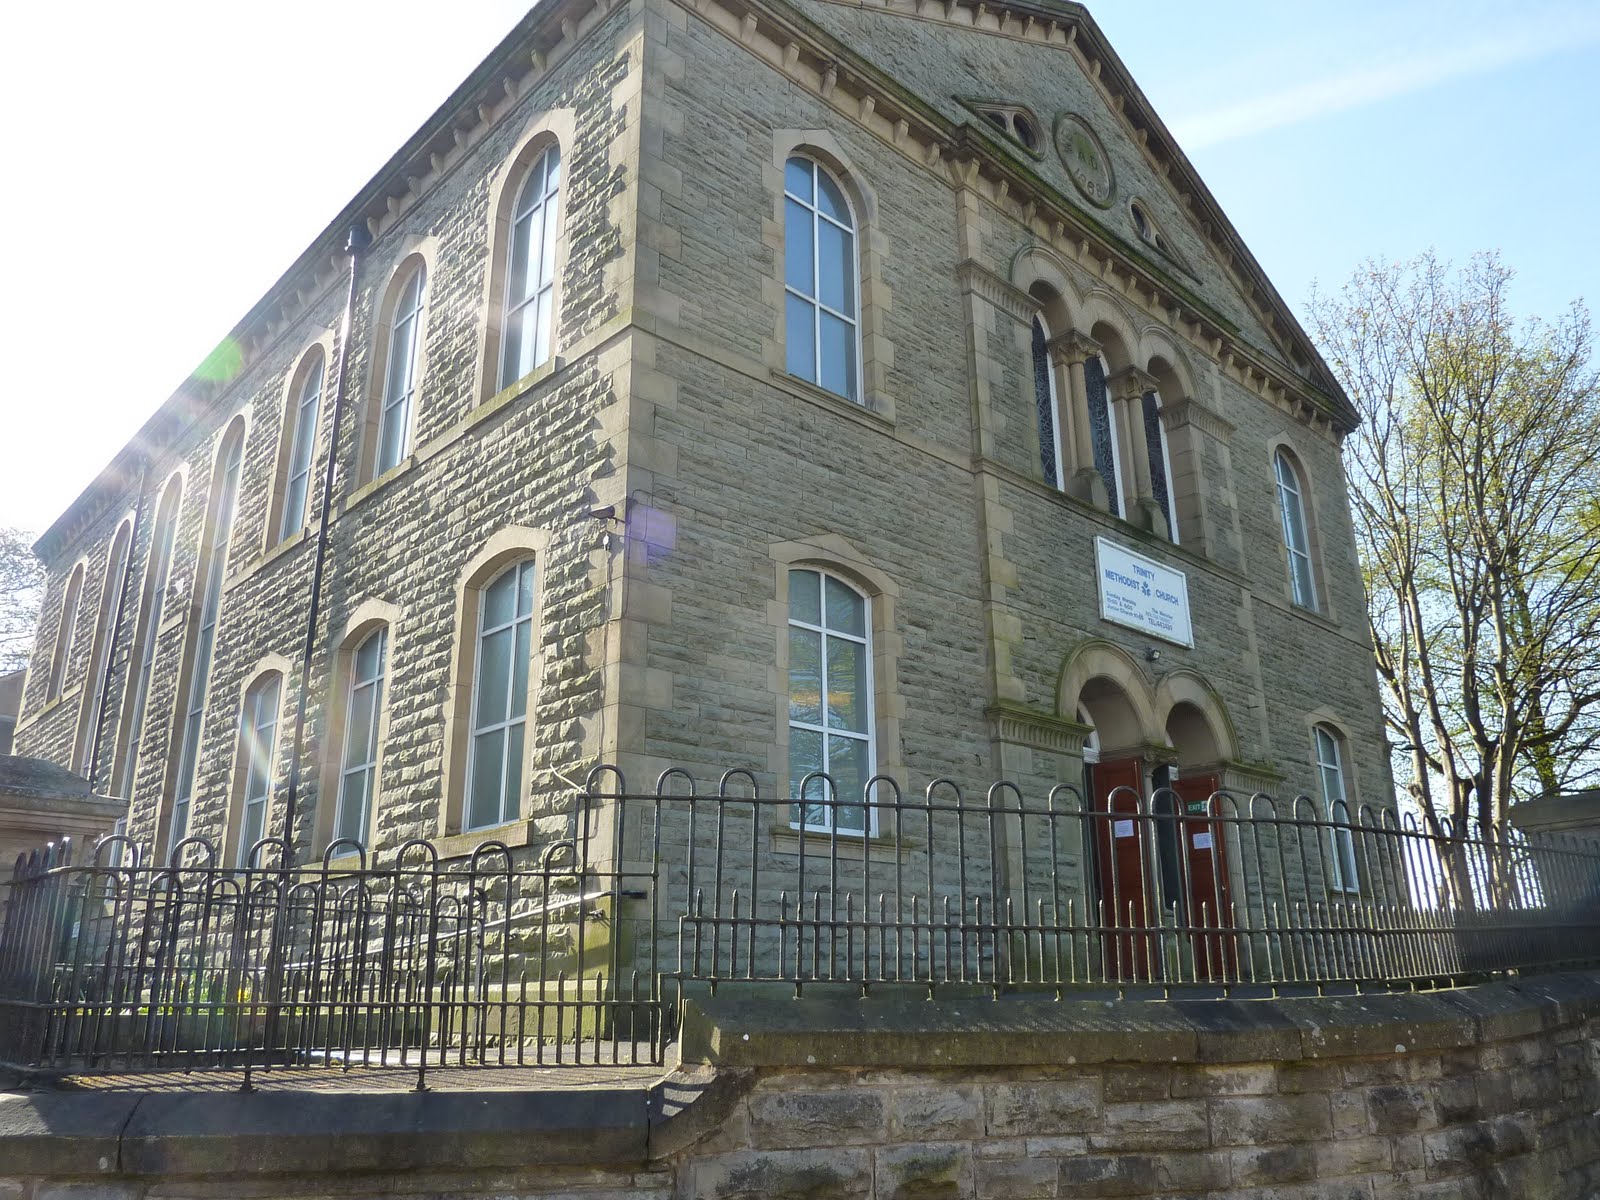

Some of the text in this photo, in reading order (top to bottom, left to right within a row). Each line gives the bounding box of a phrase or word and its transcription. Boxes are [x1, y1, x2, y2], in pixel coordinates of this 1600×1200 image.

[1132, 564, 1155, 581] TRINITY
[1105, 569, 1179, 606] METHODIST CHURCH
